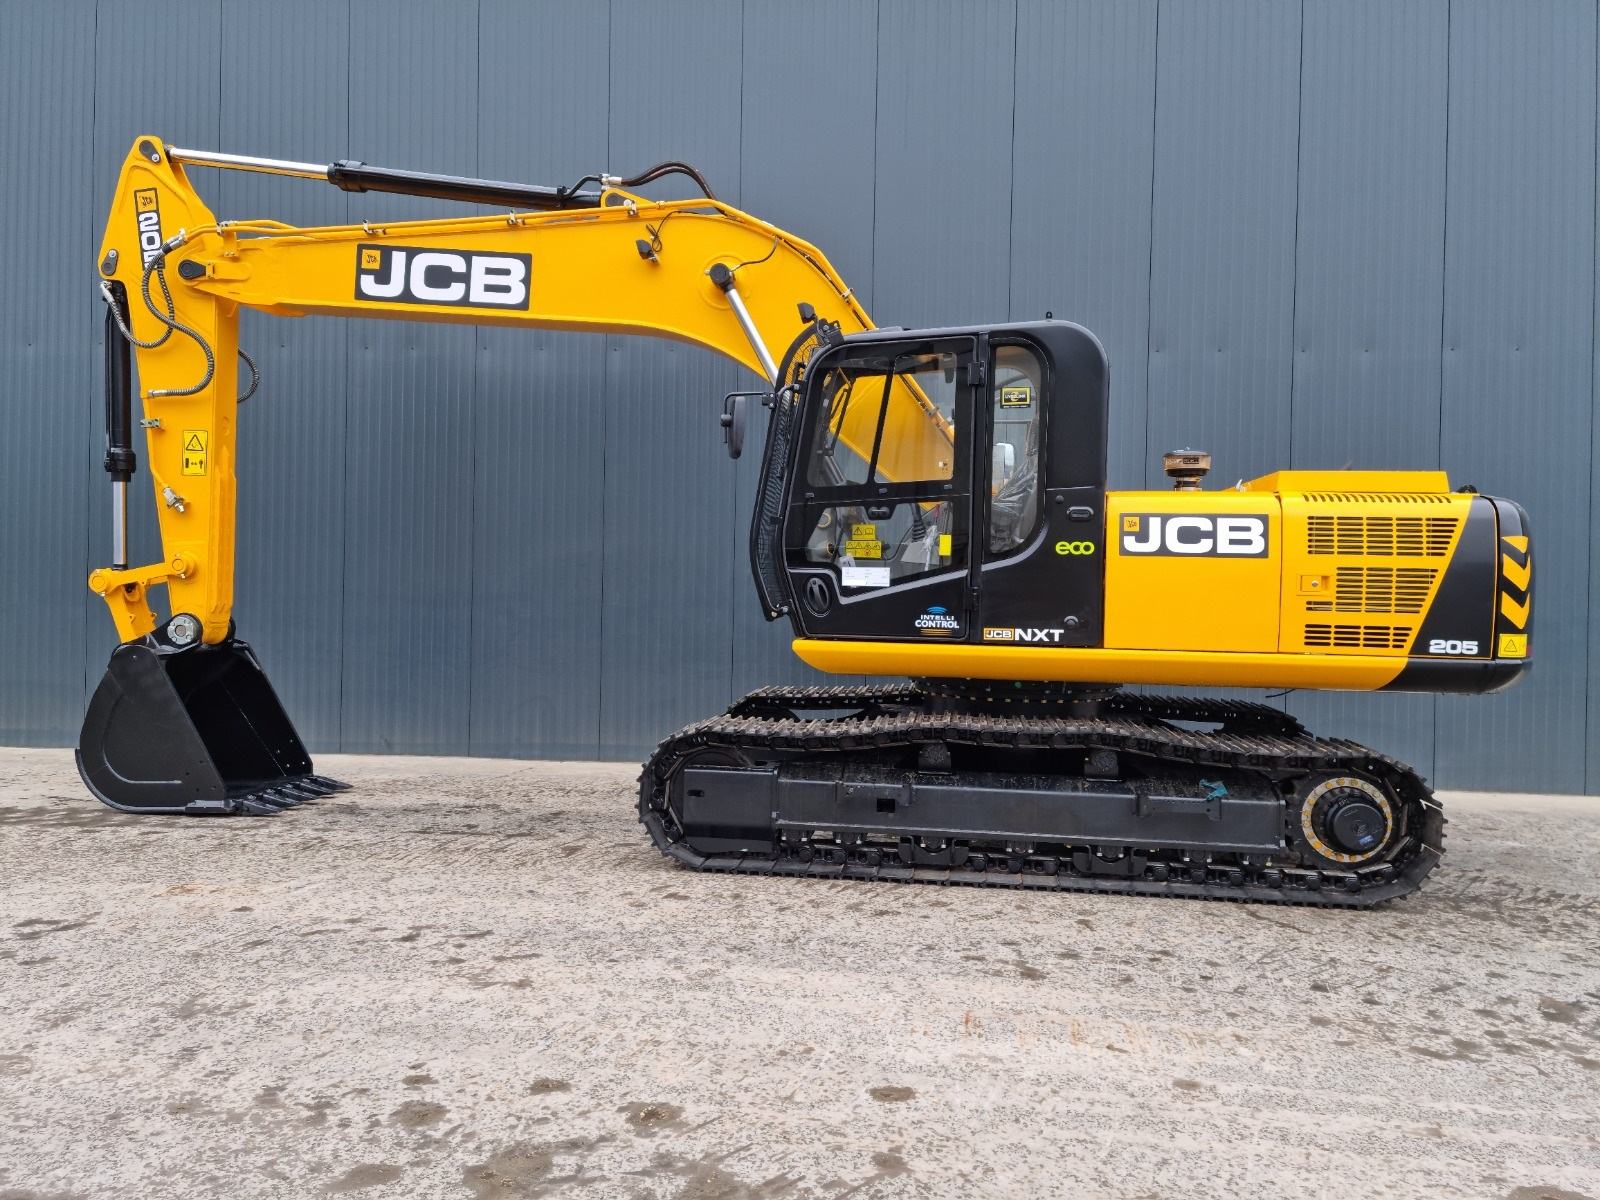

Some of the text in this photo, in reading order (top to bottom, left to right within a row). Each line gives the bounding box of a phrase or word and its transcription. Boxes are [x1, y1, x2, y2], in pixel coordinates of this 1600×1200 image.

[360, 250, 526, 305] JCB
[1123, 516, 1266, 554] JCB
[1055, 541, 1095, 555] eco
[914, 619, 960, 629] CONTROL
[985, 628, 1065, 642] JCB NXT
[1429, 639, 1479, 655] 205
